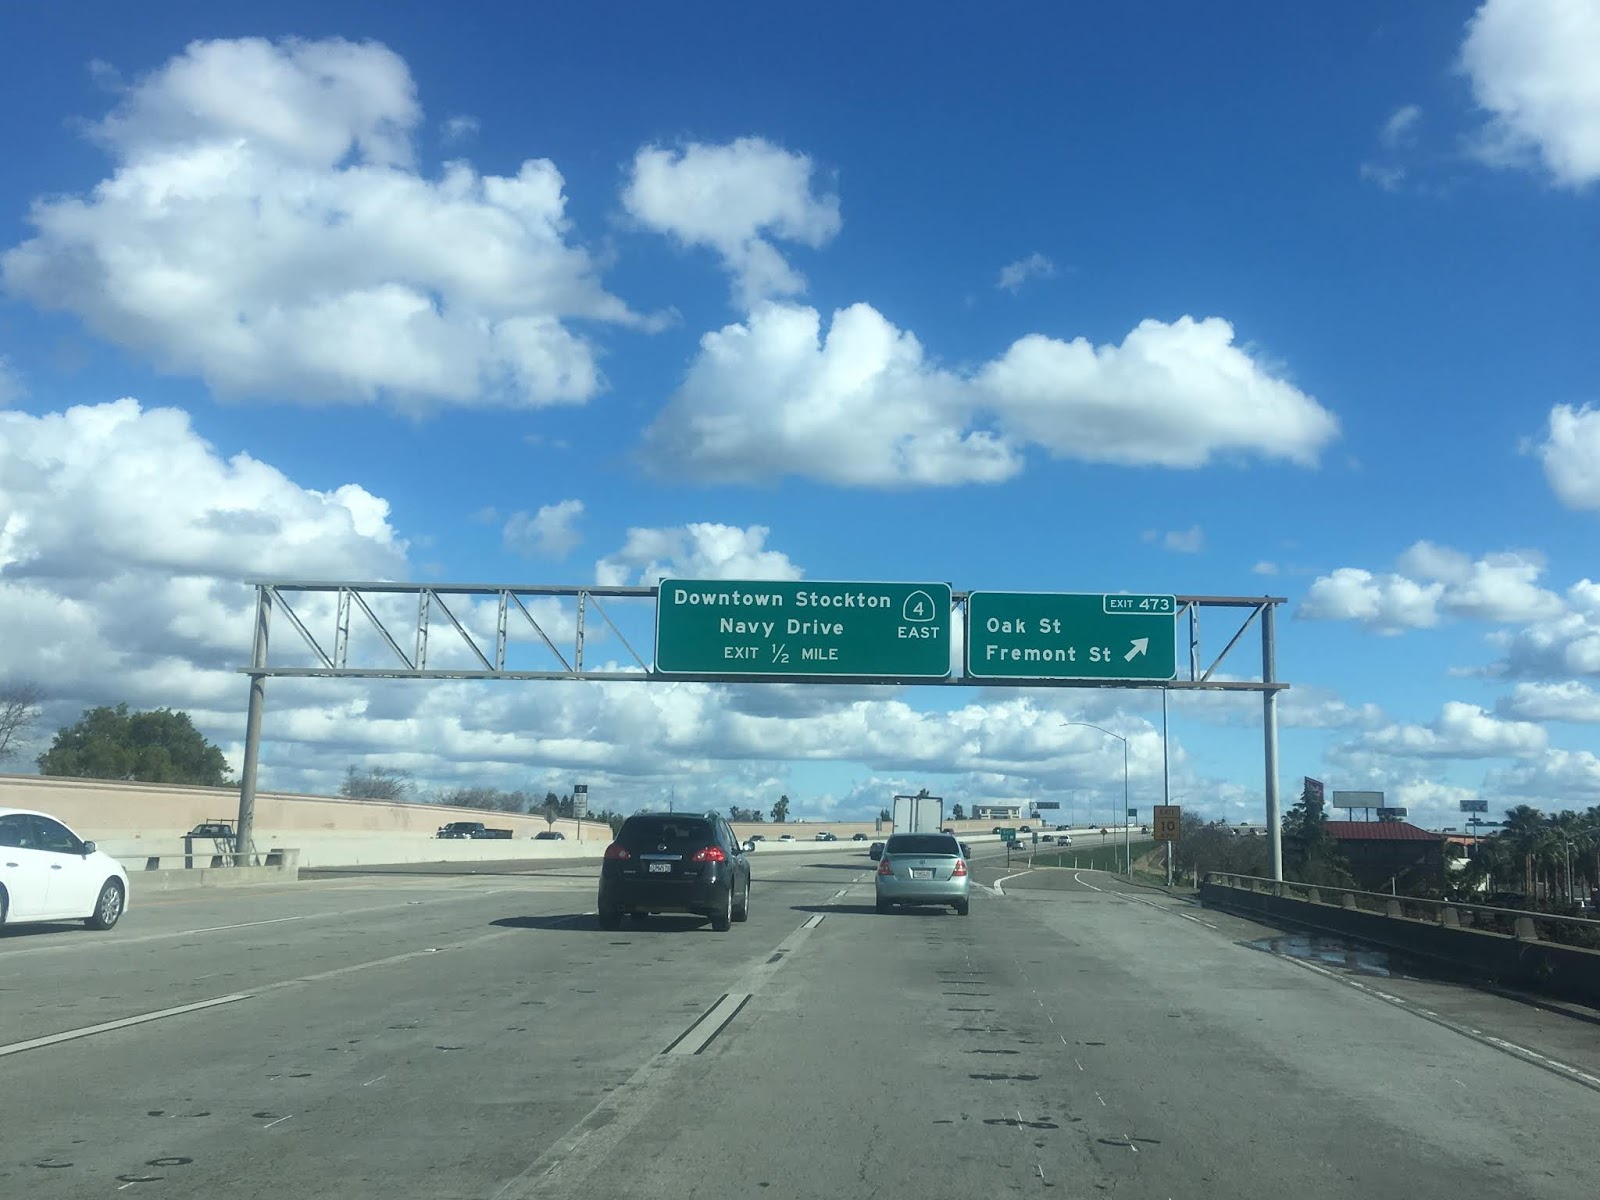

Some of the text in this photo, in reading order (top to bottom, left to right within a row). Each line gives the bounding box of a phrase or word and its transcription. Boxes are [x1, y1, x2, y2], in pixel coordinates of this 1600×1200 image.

[674, 589, 891, 608] Downtown Stockton
[1110, 598, 1170, 611] EXIT 473
[912, 601, 924, 616] 4
[720, 618, 844, 638] Navy Drive
[897, 626, 940, 639] EAST
[986, 617, 1061, 634] Oak St
[724, 646, 759, 659] EXIT
[801, 648, 839, 661] MILE
[986, 645, 1111, 663] Fremont St
[1161, 820, 1175, 831] 10
